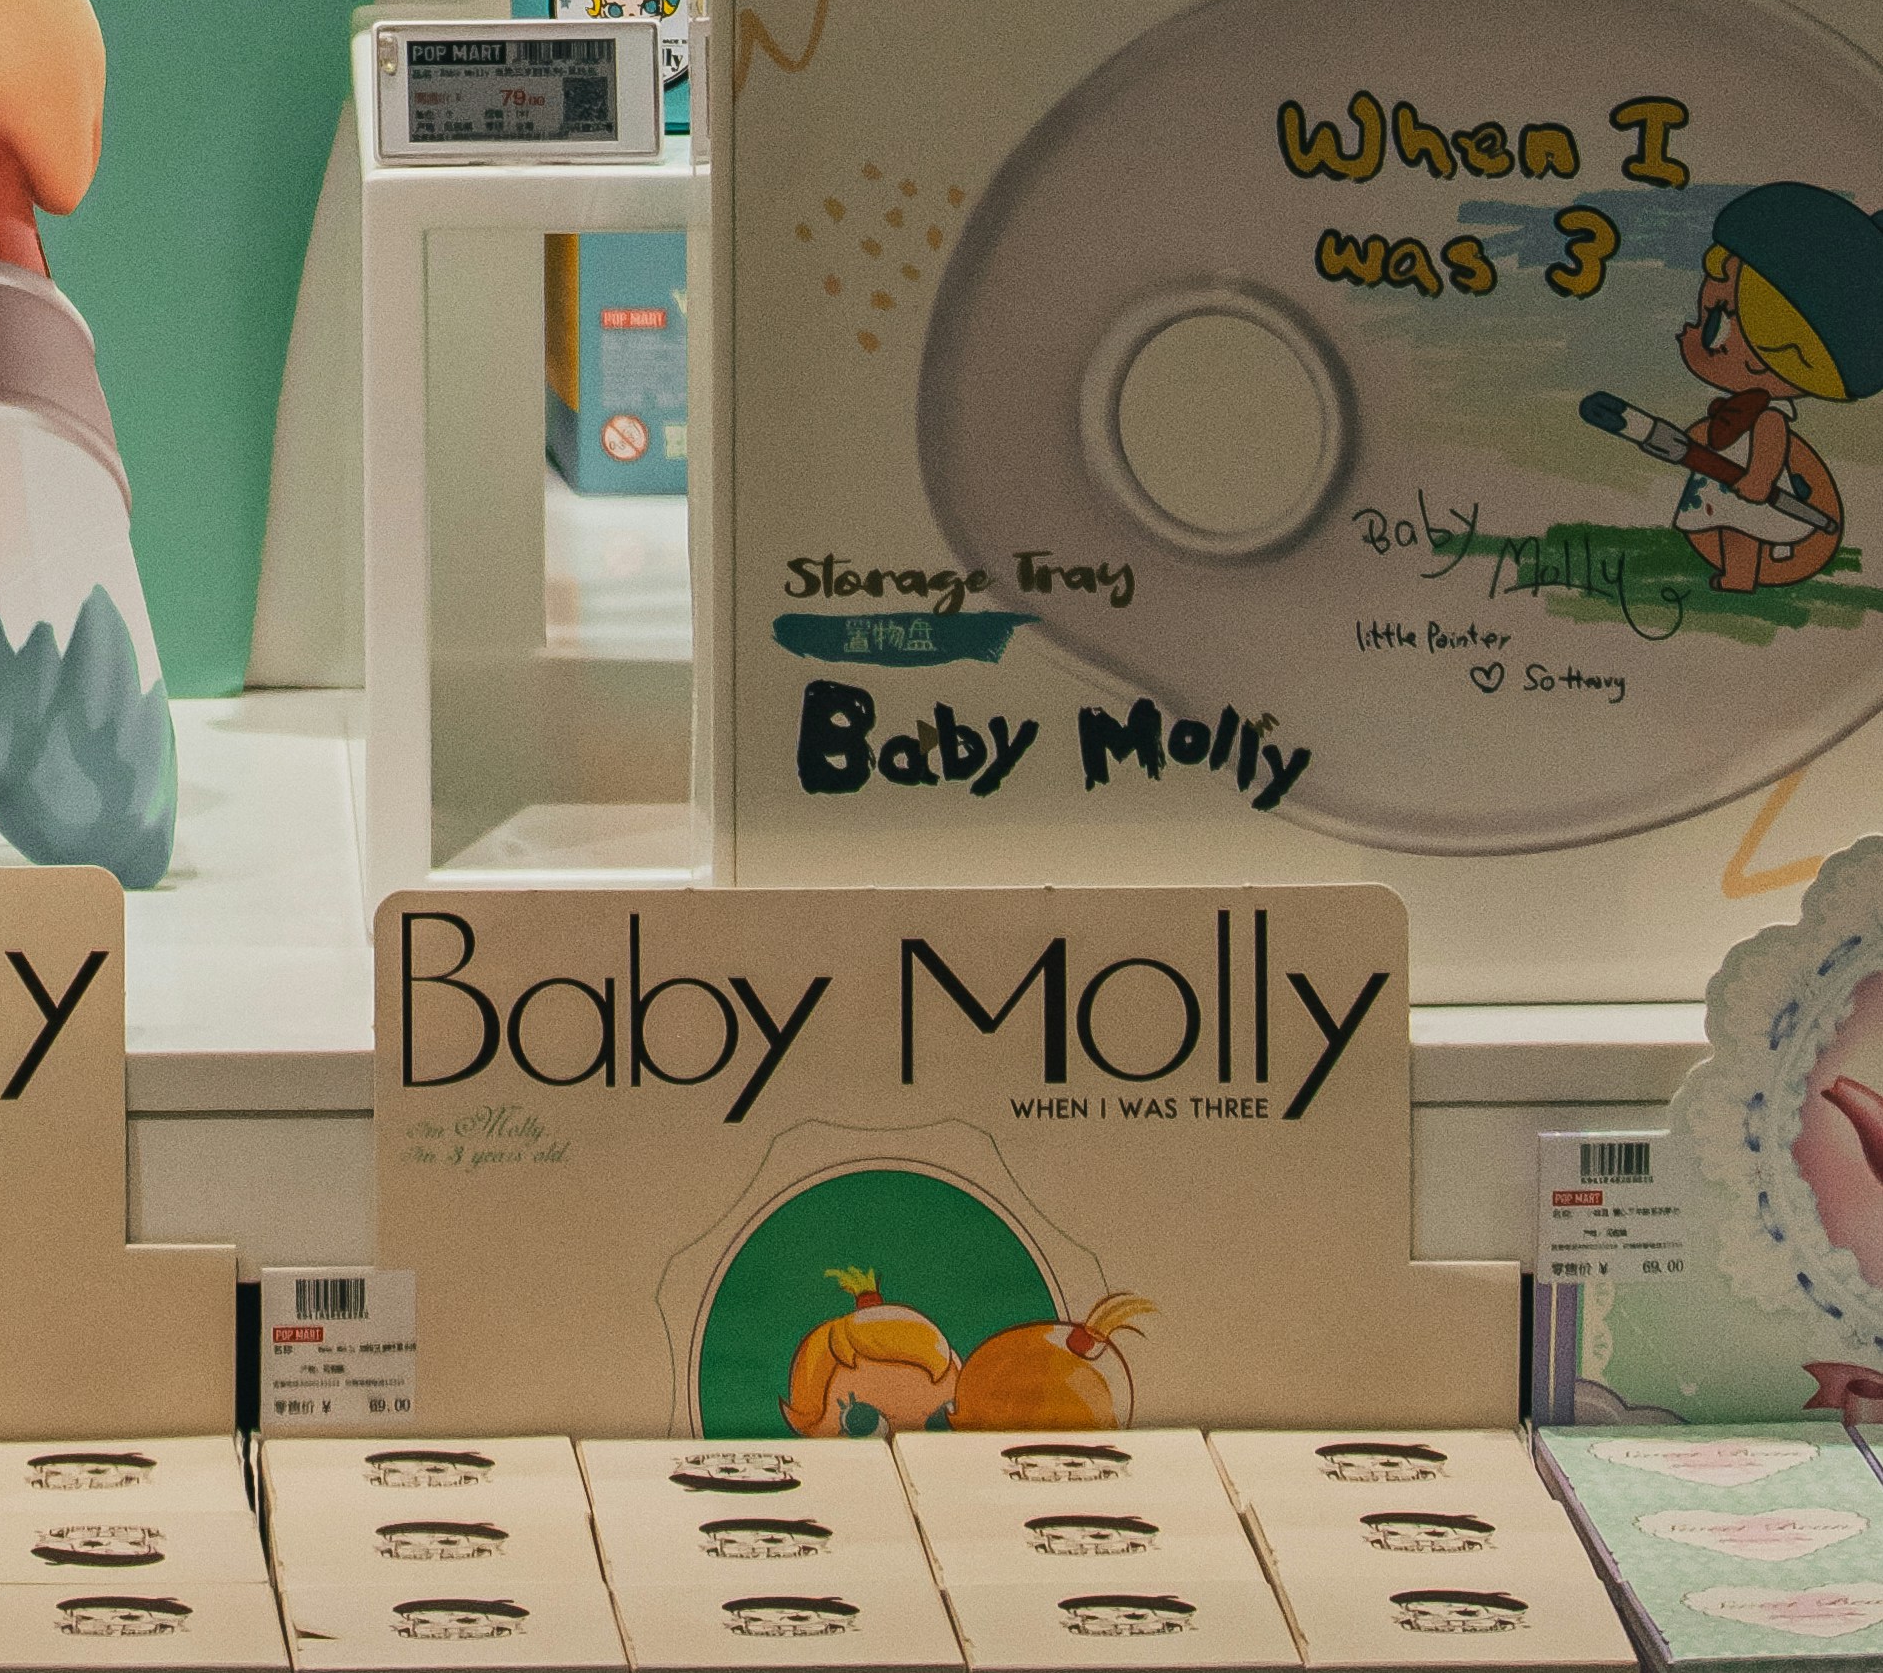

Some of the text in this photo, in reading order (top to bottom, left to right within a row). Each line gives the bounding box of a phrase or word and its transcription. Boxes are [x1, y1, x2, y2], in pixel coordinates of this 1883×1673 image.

[411, 43, 503, 62] POP MART
[1276, 89, 1690, 190] When I
[1315, 204, 1621, 299] was 3
[1352, 488, 1479, 580] Baby
[784, 550, 1136, 617] Storage Tray
[1489, 531, 1692, 641] Molly
[796, 678, 1313, 813] Baby Molly
[401, 909, 1391, 1123] Baby Molly
[1010, 1097, 1269, 1119] WHEN I WAS THREE
[1554, 1193, 1601, 1205] POP MART
[1642, 1260, 1684, 1275] 69.00
[275, 1329, 321, 1342] POP MART
